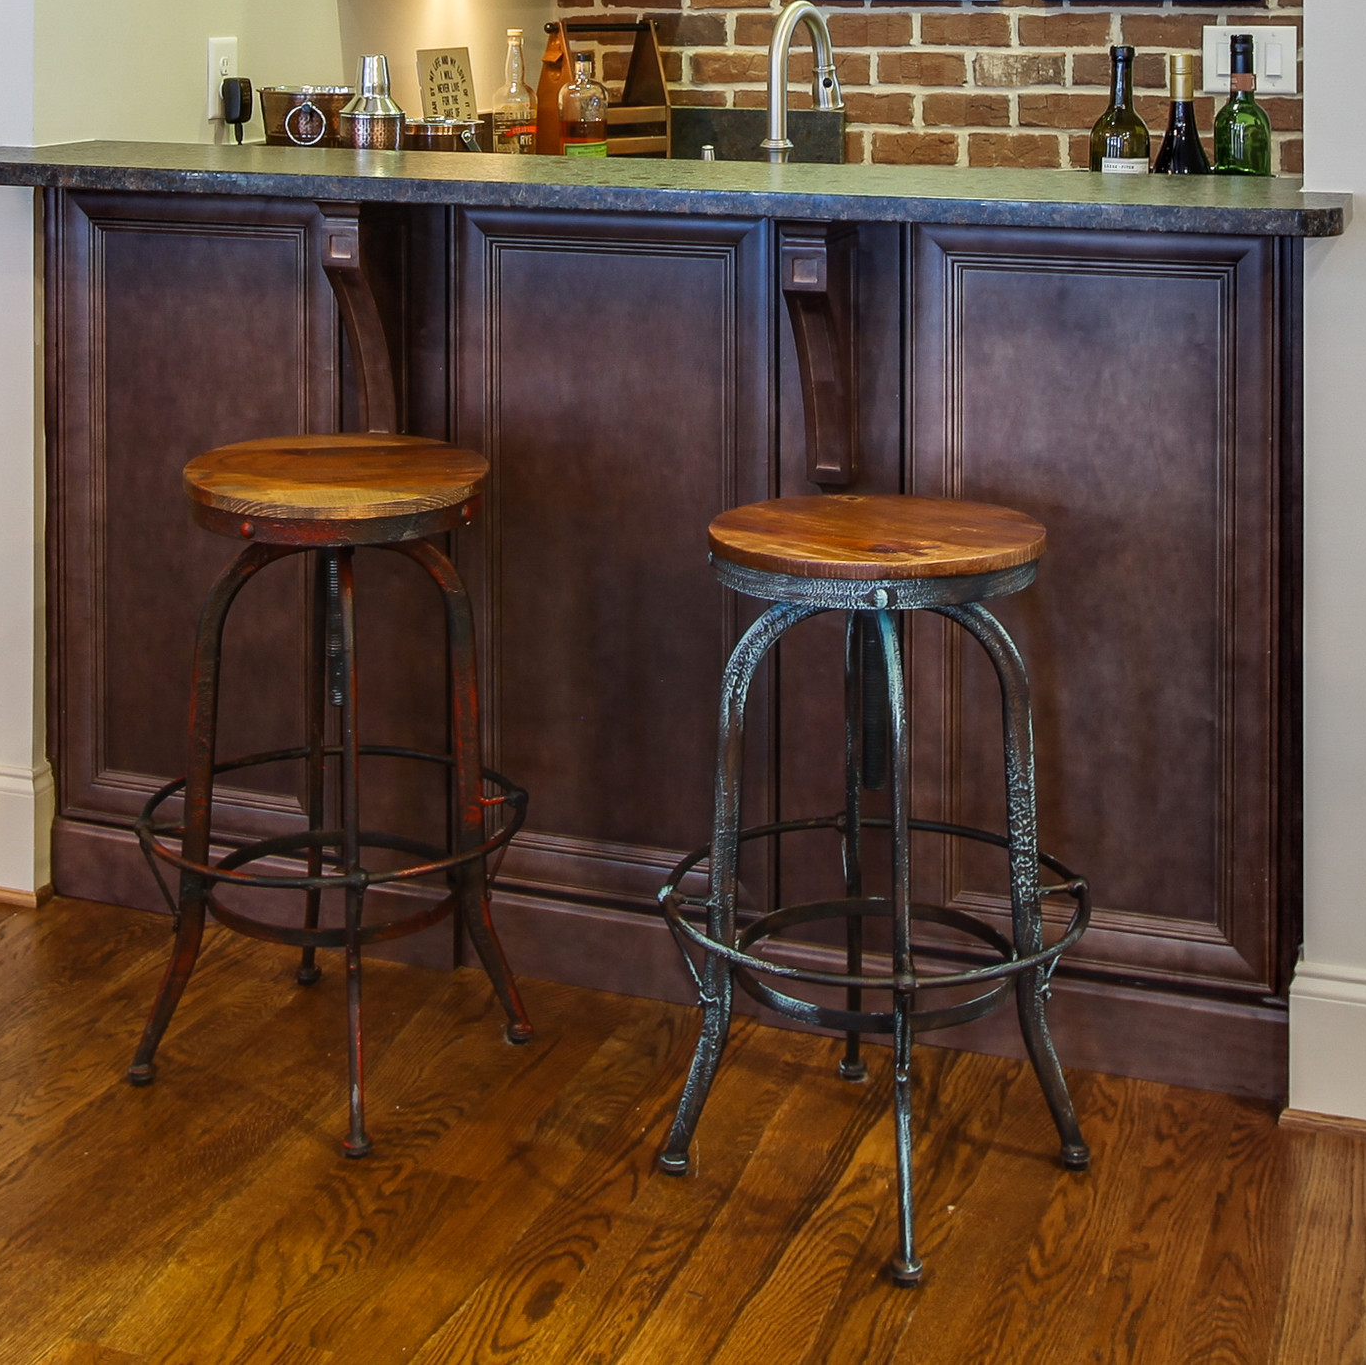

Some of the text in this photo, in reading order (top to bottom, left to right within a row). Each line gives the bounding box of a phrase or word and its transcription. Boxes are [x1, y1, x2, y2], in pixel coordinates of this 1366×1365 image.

[432, 57, 442, 71] LIFE
[441, 55, 449, 65] AND
[444, 70, 453, 80] WILL
[437, 82, 460, 93] NEVER LIVE
[442, 95, 459, 106] FOR THE
[443, 108, 454, 118] SAKE
[455, 108, 460, 117] OF
[520, 135, 533, 145] RYE
